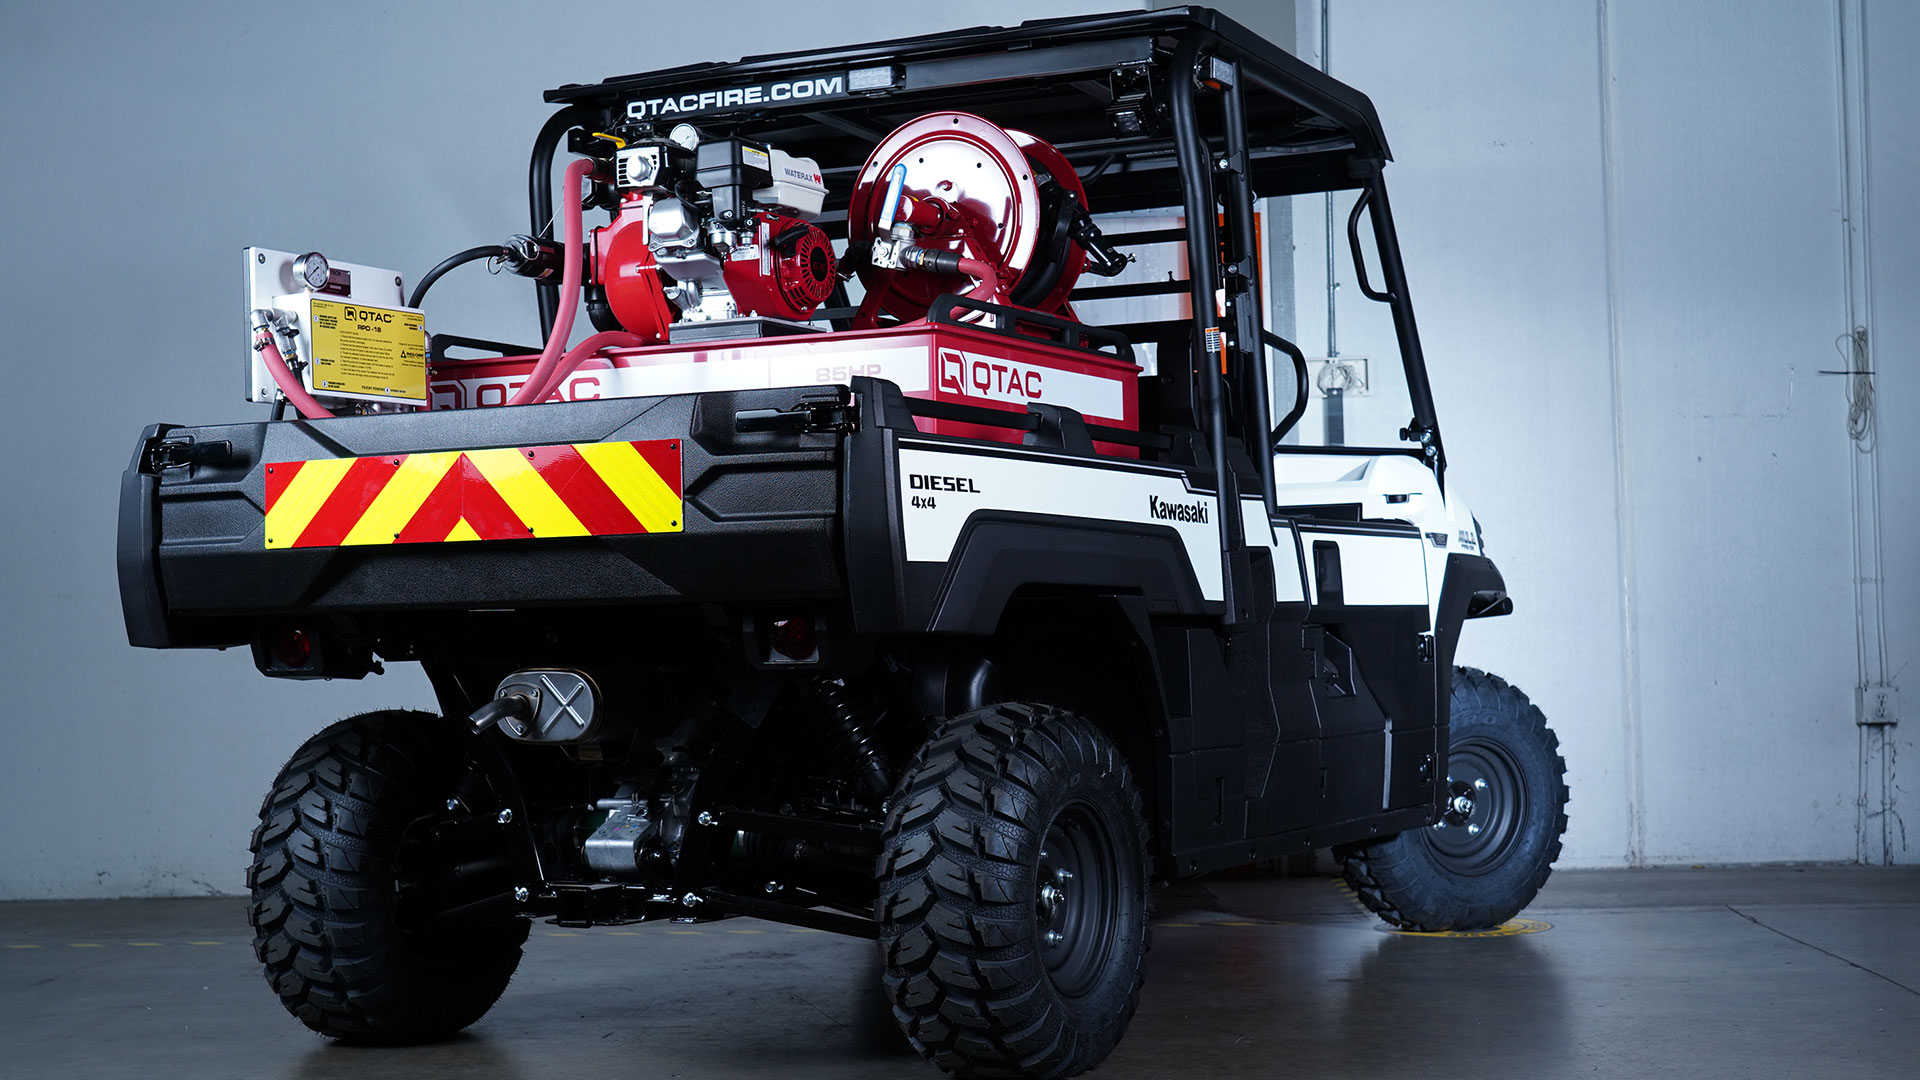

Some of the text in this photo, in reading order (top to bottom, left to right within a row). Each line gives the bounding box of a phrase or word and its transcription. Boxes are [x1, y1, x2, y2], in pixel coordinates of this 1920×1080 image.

[627, 77, 842, 119] QTACFIRE.COM
[784, 167, 813, 182] WATERAX
[359, 310, 392, 323] QTAC
[815, 364, 882, 382] 85HP
[972, 361, 1042, 399] QTAC
[909, 474, 981, 494] DIESEL
[911, 495, 937, 510] 4x4
[1149, 494, 1209, 525] Kawasaki
